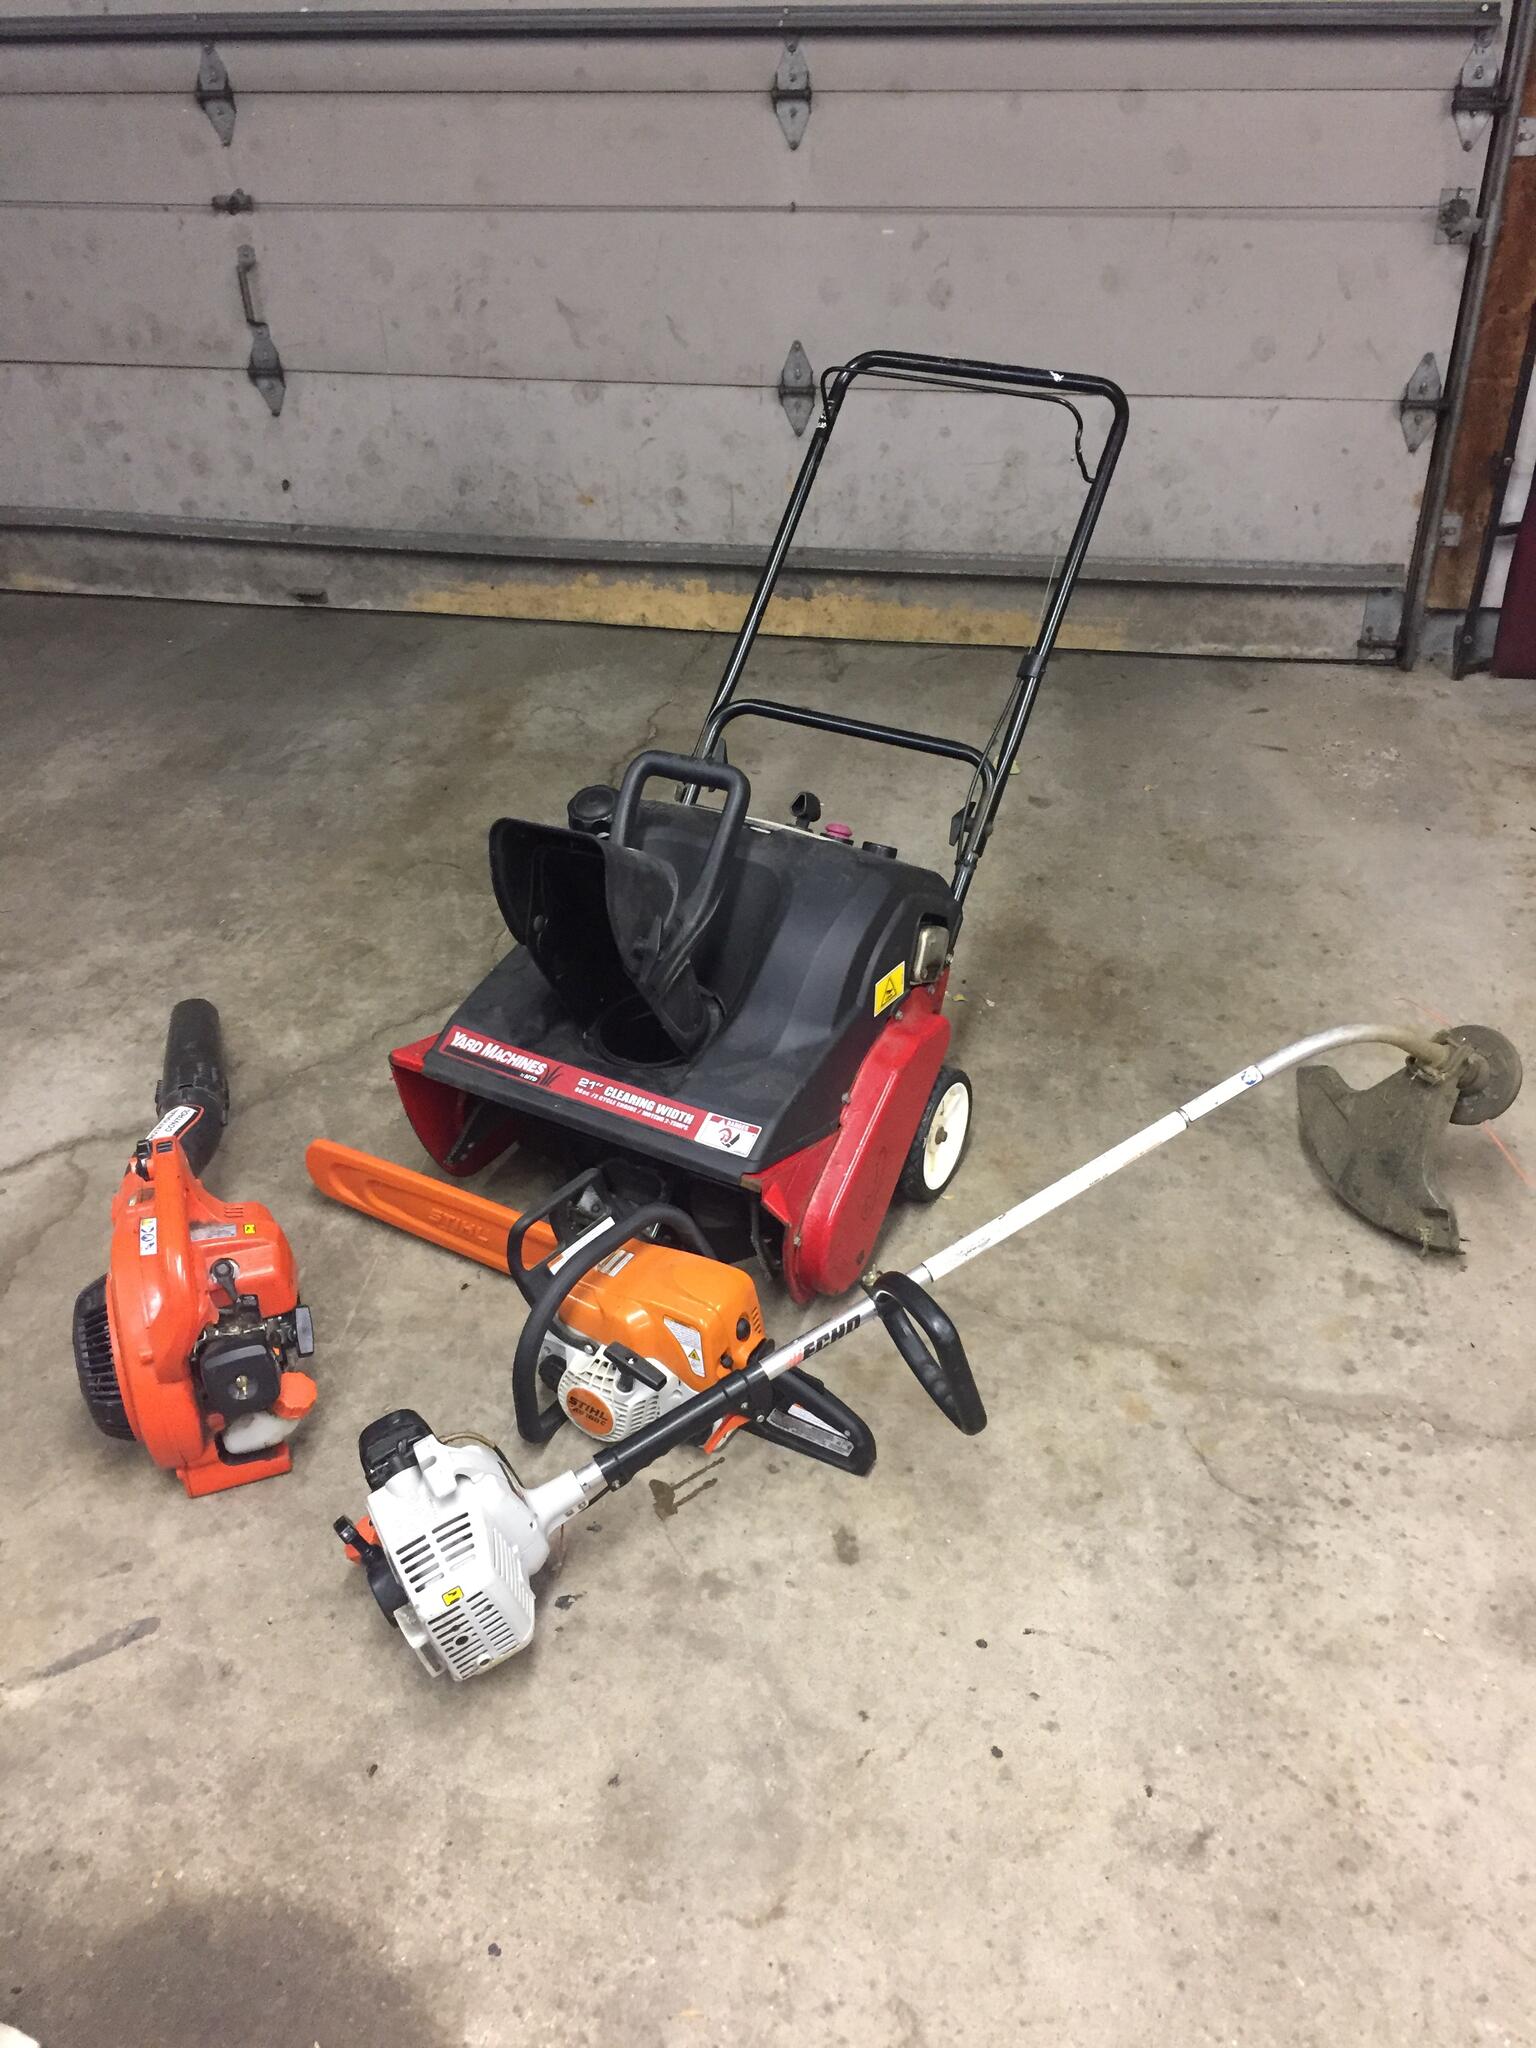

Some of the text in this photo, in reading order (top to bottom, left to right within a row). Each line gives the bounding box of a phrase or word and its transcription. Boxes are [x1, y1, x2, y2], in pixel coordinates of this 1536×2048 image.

[450, 1031, 548, 1075] YARD MACHINES
[603, 1086, 656, 1111] CLEARING
[655, 1103, 695, 1125] WIDTH
[568, 1396, 608, 1421] STIHL
